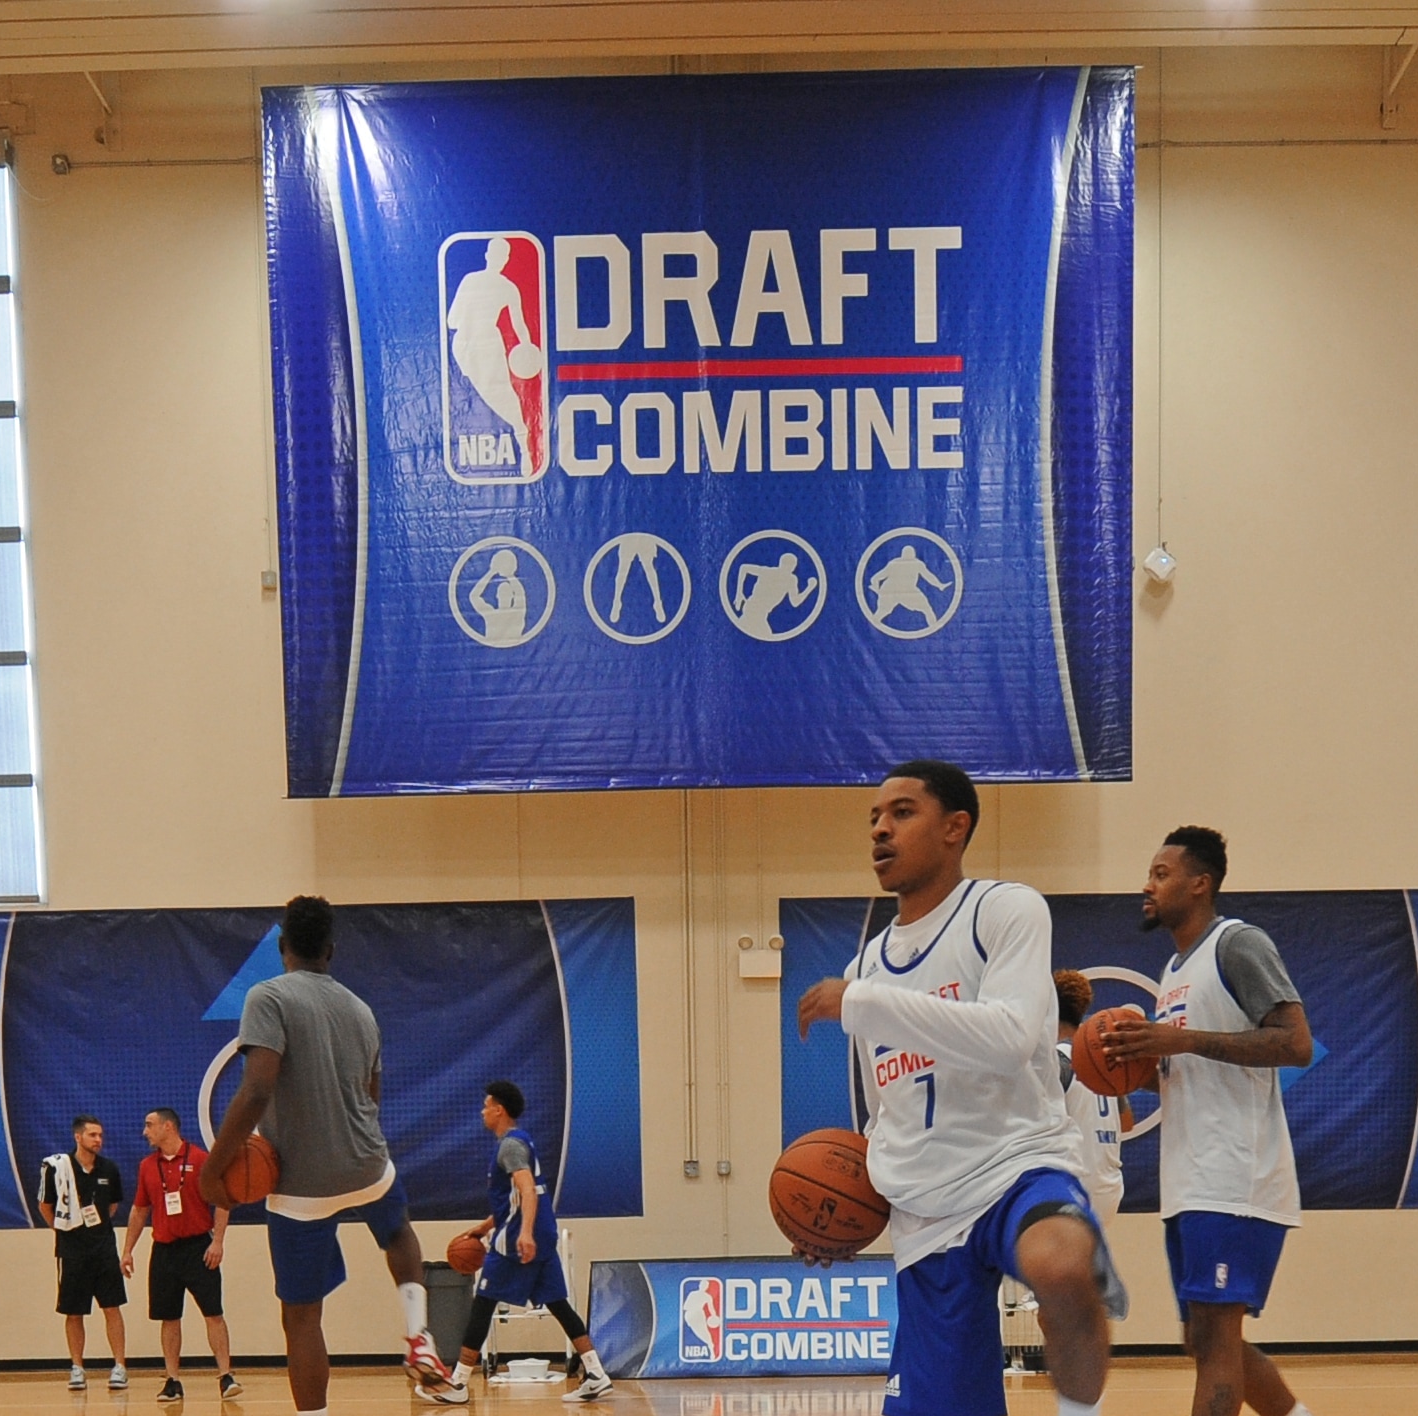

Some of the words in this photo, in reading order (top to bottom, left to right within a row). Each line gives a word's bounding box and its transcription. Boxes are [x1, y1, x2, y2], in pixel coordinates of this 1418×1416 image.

[553, 226, 962, 351] DRAFT
[458, 434, 516, 467] NBA
[558, 386, 964, 477] COMBINE
[914, 1072, 936, 1130] 7
[725, 1276, 888, 1319] DRAFT
[684, 1345, 709, 1358] NBA
[725, 1331, 891, 1361] COMBINE
